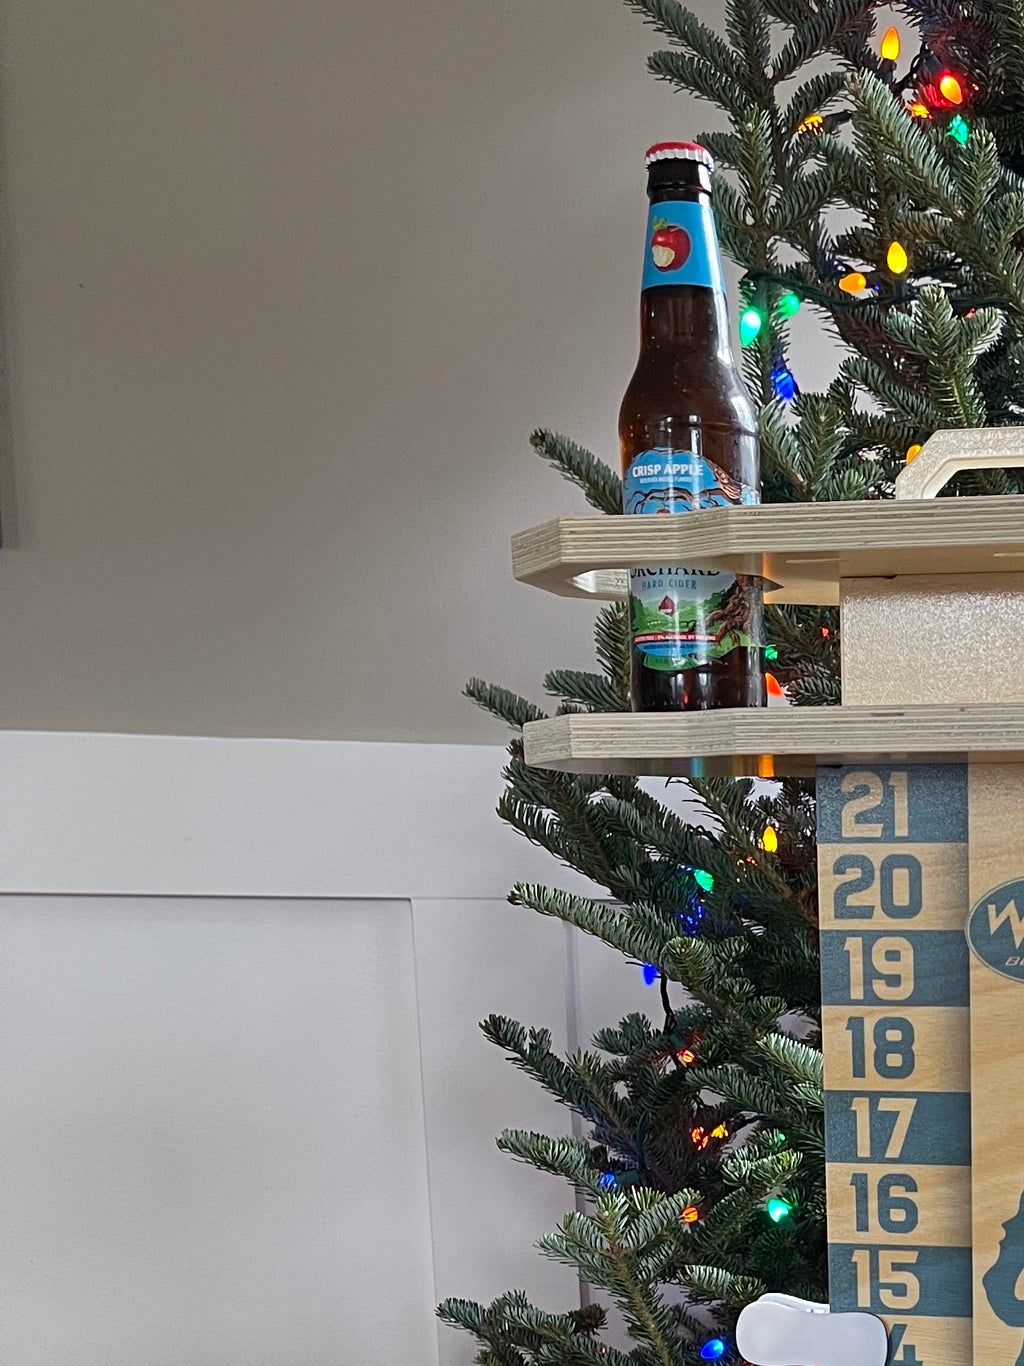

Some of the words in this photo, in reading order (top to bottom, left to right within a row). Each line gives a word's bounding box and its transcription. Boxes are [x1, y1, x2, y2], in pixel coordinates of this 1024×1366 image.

[632, 464, 661, 478] CRISP
[664, 463, 703, 476] APPLE
[641, 579, 663, 590] HARD
[668, 579, 697, 590] CIDER
[841, 772, 908, 837] 21
[833, 854, 922, 919] 20
[844, 936, 915, 1000] 19
[846, 1017, 915, 1078] 18
[851, 1097, 917, 1158] 17
[850, 1173, 918, 1233] 16
[852, 1250, 920, 1309] 15
